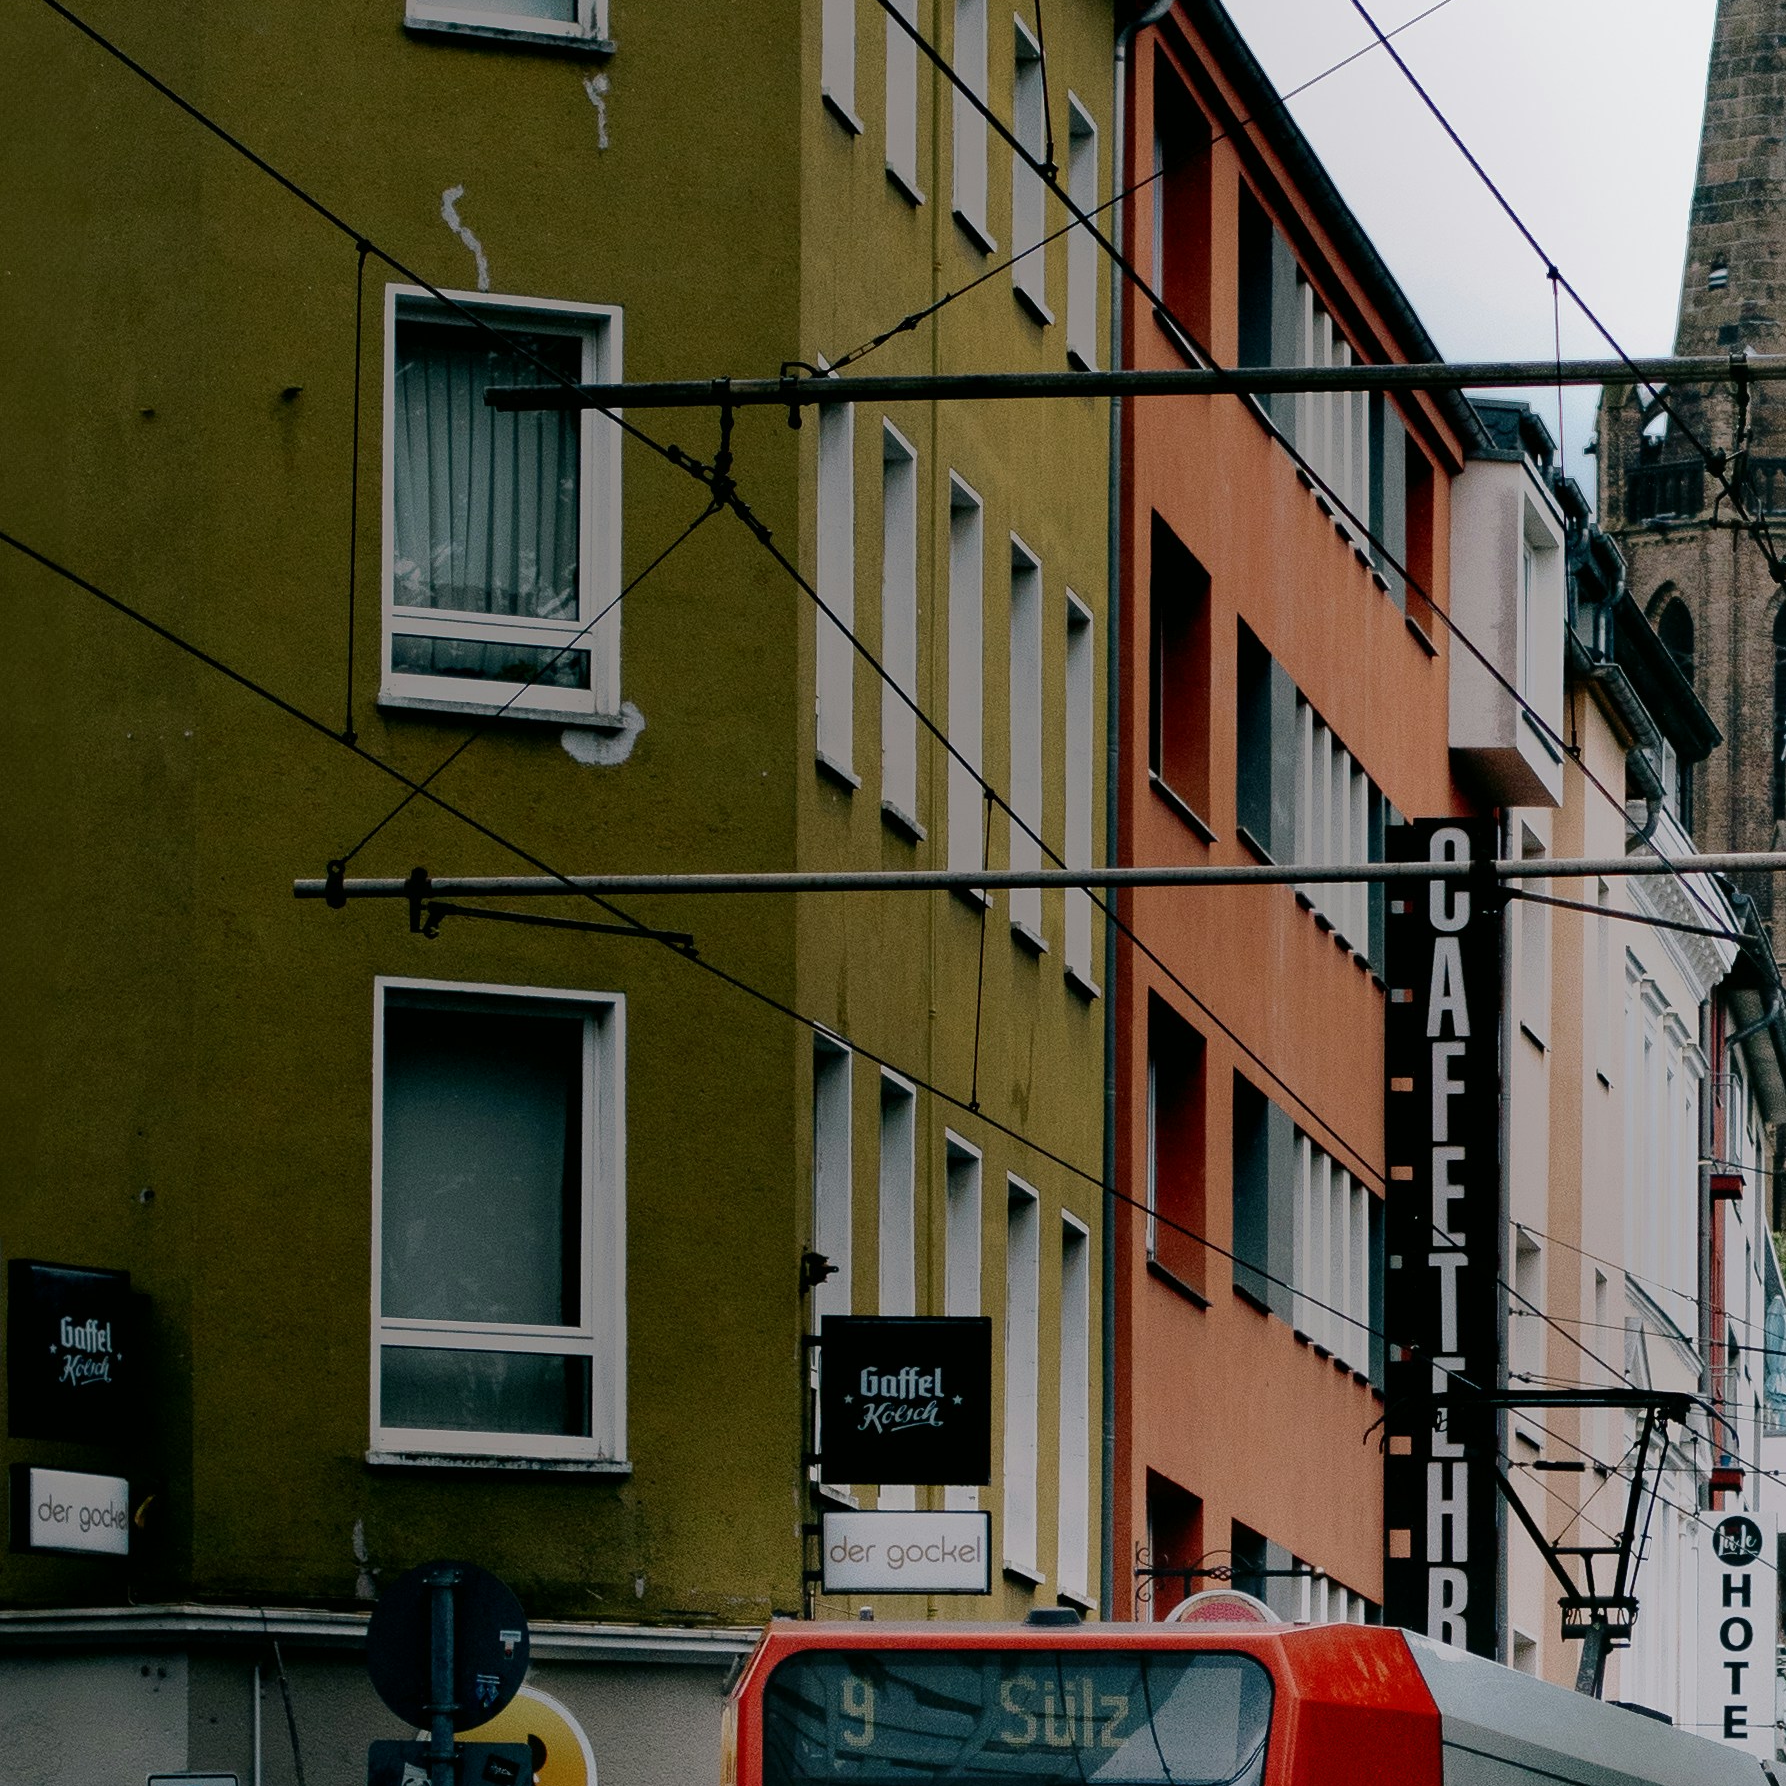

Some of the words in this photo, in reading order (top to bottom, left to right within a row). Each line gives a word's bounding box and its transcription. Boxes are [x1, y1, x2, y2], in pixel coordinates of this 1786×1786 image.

[60, 1315, 113, 1354] Gaffel
[59, 1354, 113, 1387] Kölsch
[859, 1366, 945, 1401] Gaffel
[857, 1400, 945, 1434] Kölsch
[38, 1494, 73, 1523] der
[830, 1535, 876, 1563] der
[887, 1535, 981, 1570] gockel
[841, 1674, 875, 1748] 9
[1000, 1674, 1130, 1748] Sülz
